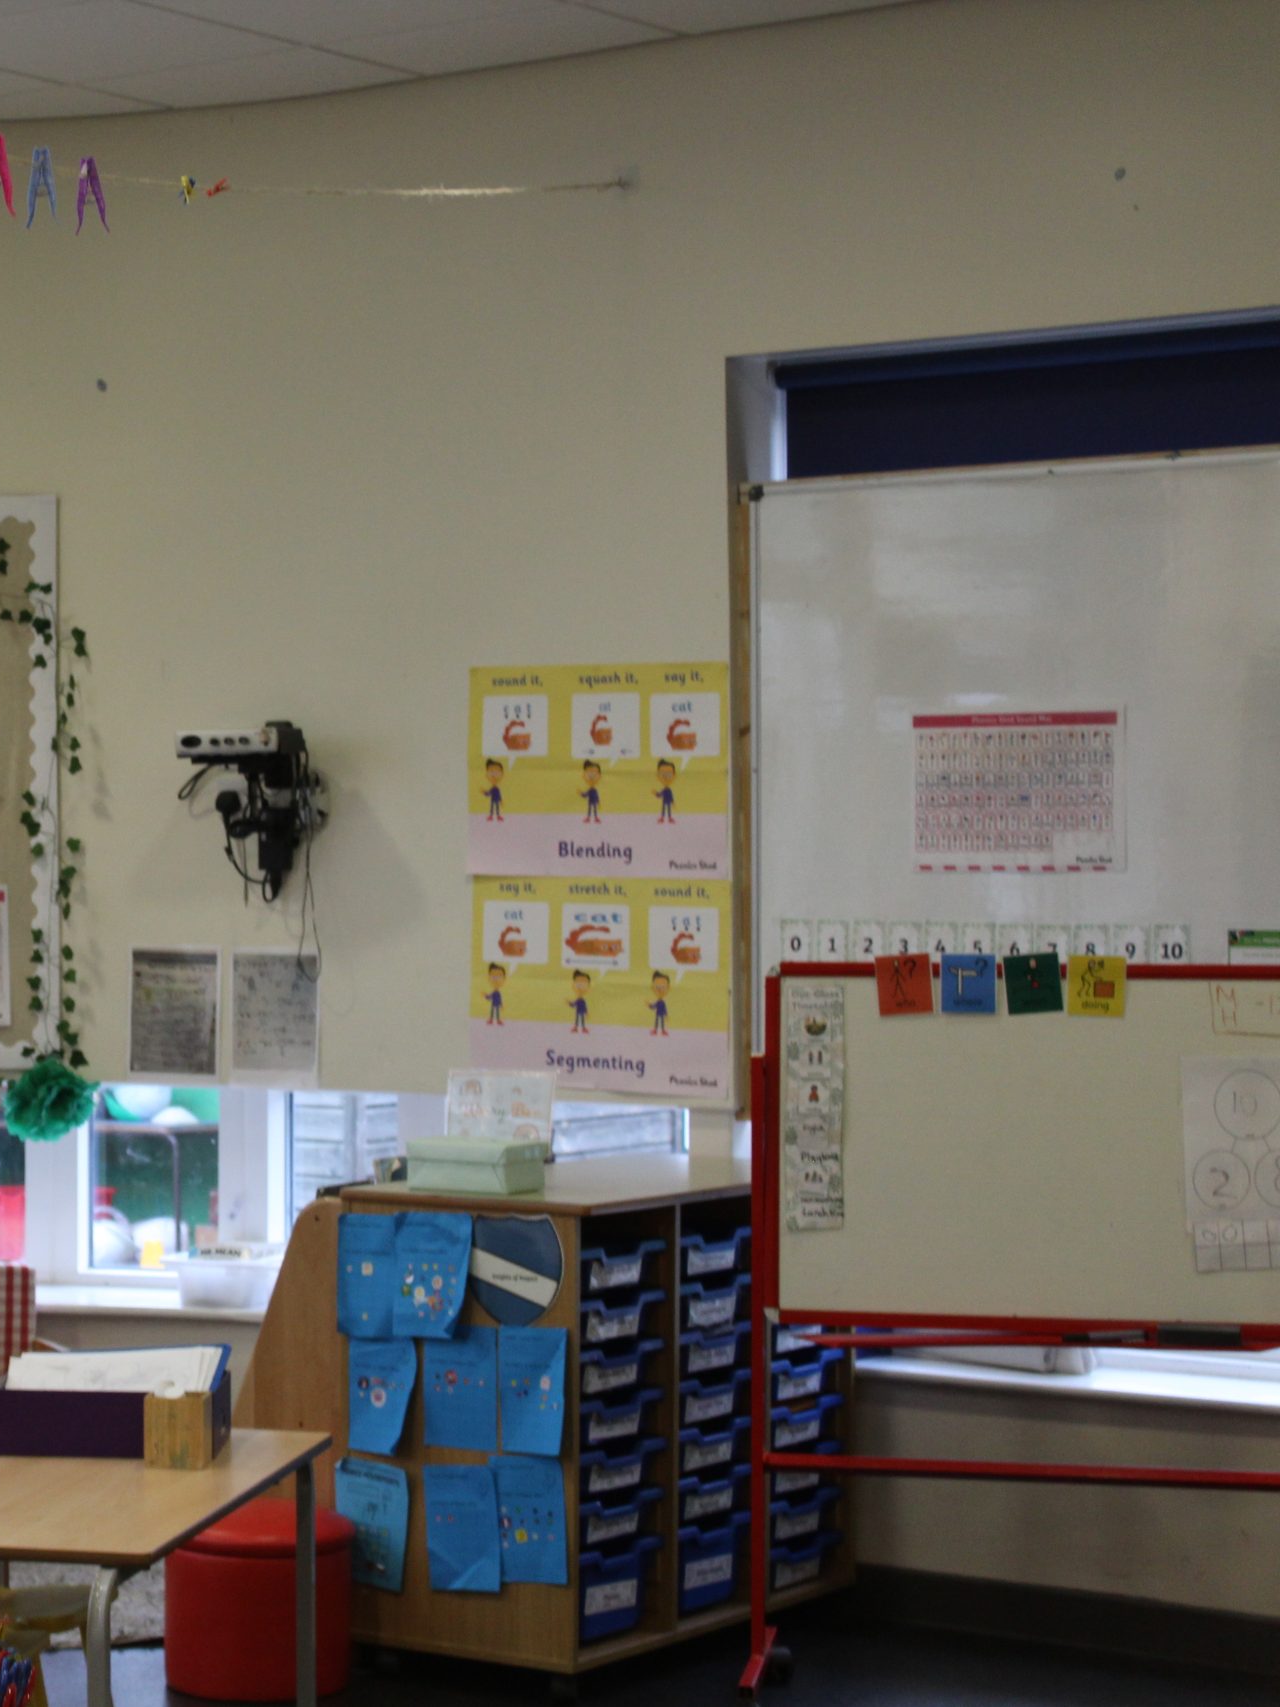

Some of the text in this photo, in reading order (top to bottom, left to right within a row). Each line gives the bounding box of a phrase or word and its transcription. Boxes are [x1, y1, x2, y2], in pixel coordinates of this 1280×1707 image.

[492, 675, 526, 687] sound
[579, 671, 621, 689] squash
[664, 672, 686, 685] say
[671, 701, 693, 713] cat
[558, 841, 633, 864] Blending
[499, 883, 520, 896] say
[568, 883, 609, 895] stretch
[654, 886, 692, 898] sound
[504, 910, 524, 921] cat
[790, 935, 801, 951] 0
[828, 937, 836, 953] 1
[863, 938, 873, 953] 2
[899, 938, 909, 954] 3
[1009, 942, 1020, 956] 6
[1085, 942, 1096, 956] 8
[1125, 943, 1136, 959] 9
[1161, 943, 1184, 959] 10
[1081, 1000, 1110, 1011] doing
[545, 1049, 646, 1078] Segmenting
[1232, 1090, 1258, 1118] 10
[1209, 1167, 1238, 1199] 2
